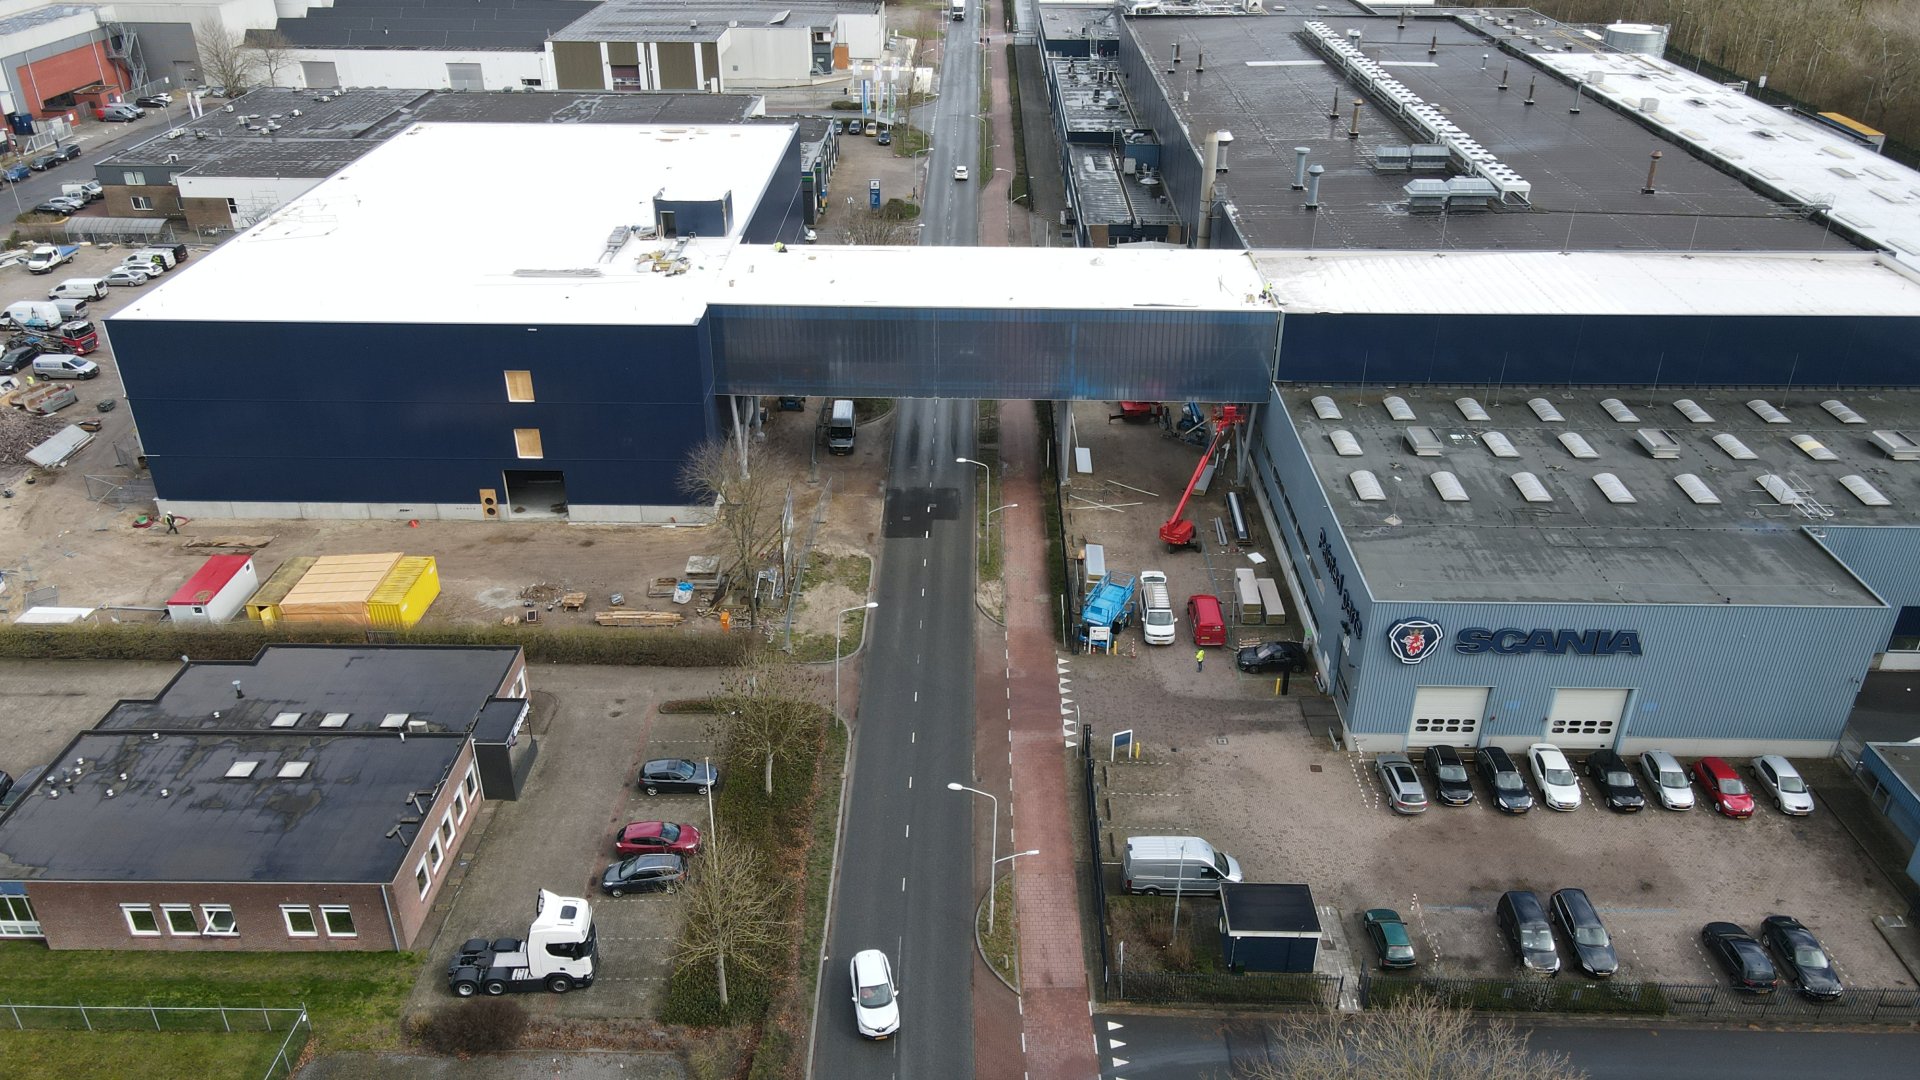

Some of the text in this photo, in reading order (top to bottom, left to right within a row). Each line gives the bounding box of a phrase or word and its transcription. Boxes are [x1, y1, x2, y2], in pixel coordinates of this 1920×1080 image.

[1318, 527, 1363, 639] Painted parts
[1455, 627, 1643, 657] SCANIA
